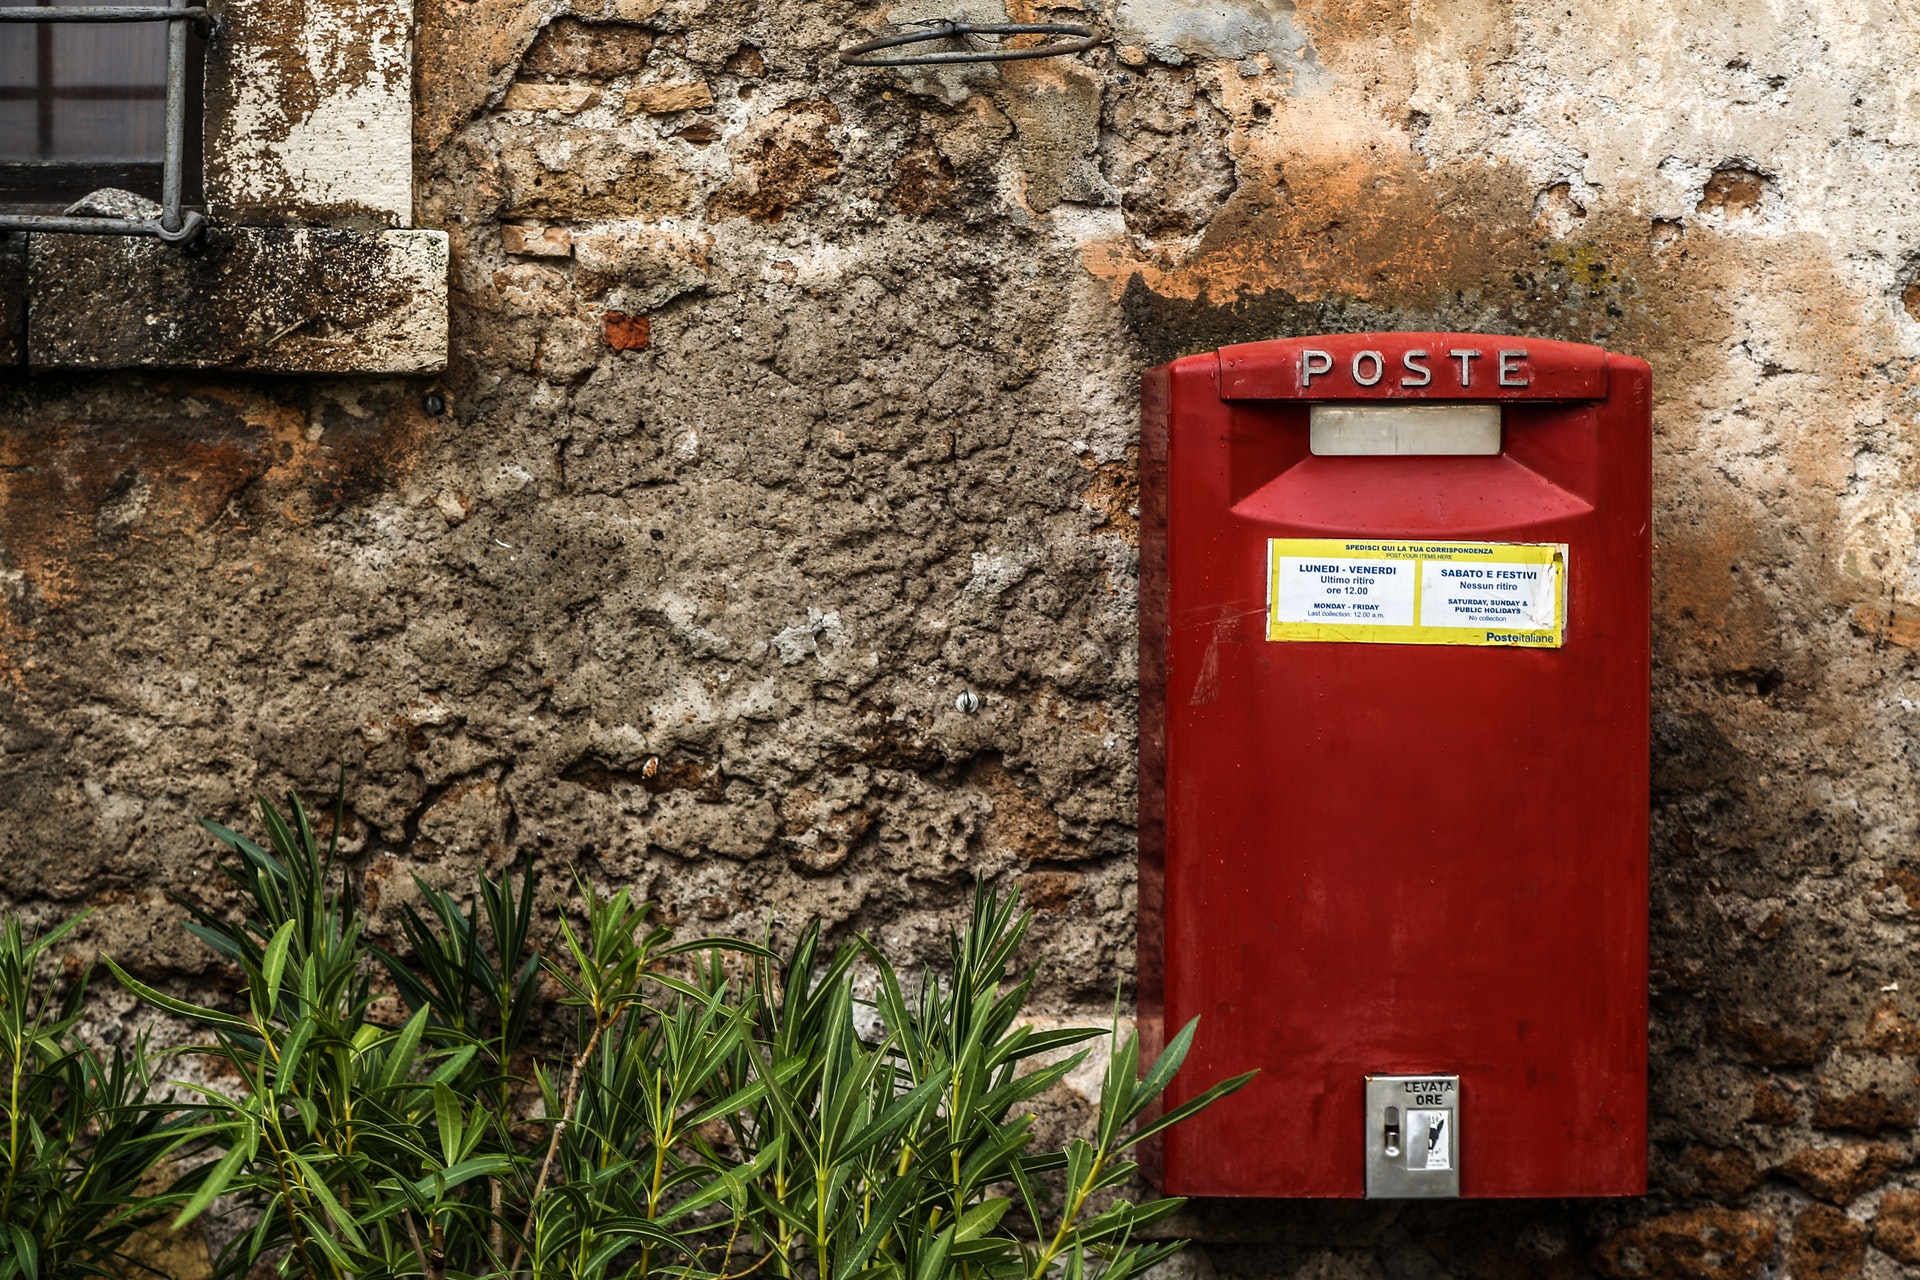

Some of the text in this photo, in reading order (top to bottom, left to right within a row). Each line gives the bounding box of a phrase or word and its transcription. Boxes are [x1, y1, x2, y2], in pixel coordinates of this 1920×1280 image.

[1302, 350, 1529, 386] POSTE
[1425, 546, 1494, 554] CORRISPONDENZA
[1299, 564, 1339, 573] LUNEDI
[1349, 566, 1396, 575] VENERDI
[1441, 569, 1483, 578] SABATO
[1496, 571, 1537, 580] FESTIVI
[1320, 576, 1375, 585] Ultimo ritiro
[1345, 587, 1368, 595] 12.00
[1460, 582, 1518, 590] Nessun ritiro
[1405, 1082, 1453, 1092] LEVATA
[1416, 1094, 1442, 1104] ORE
